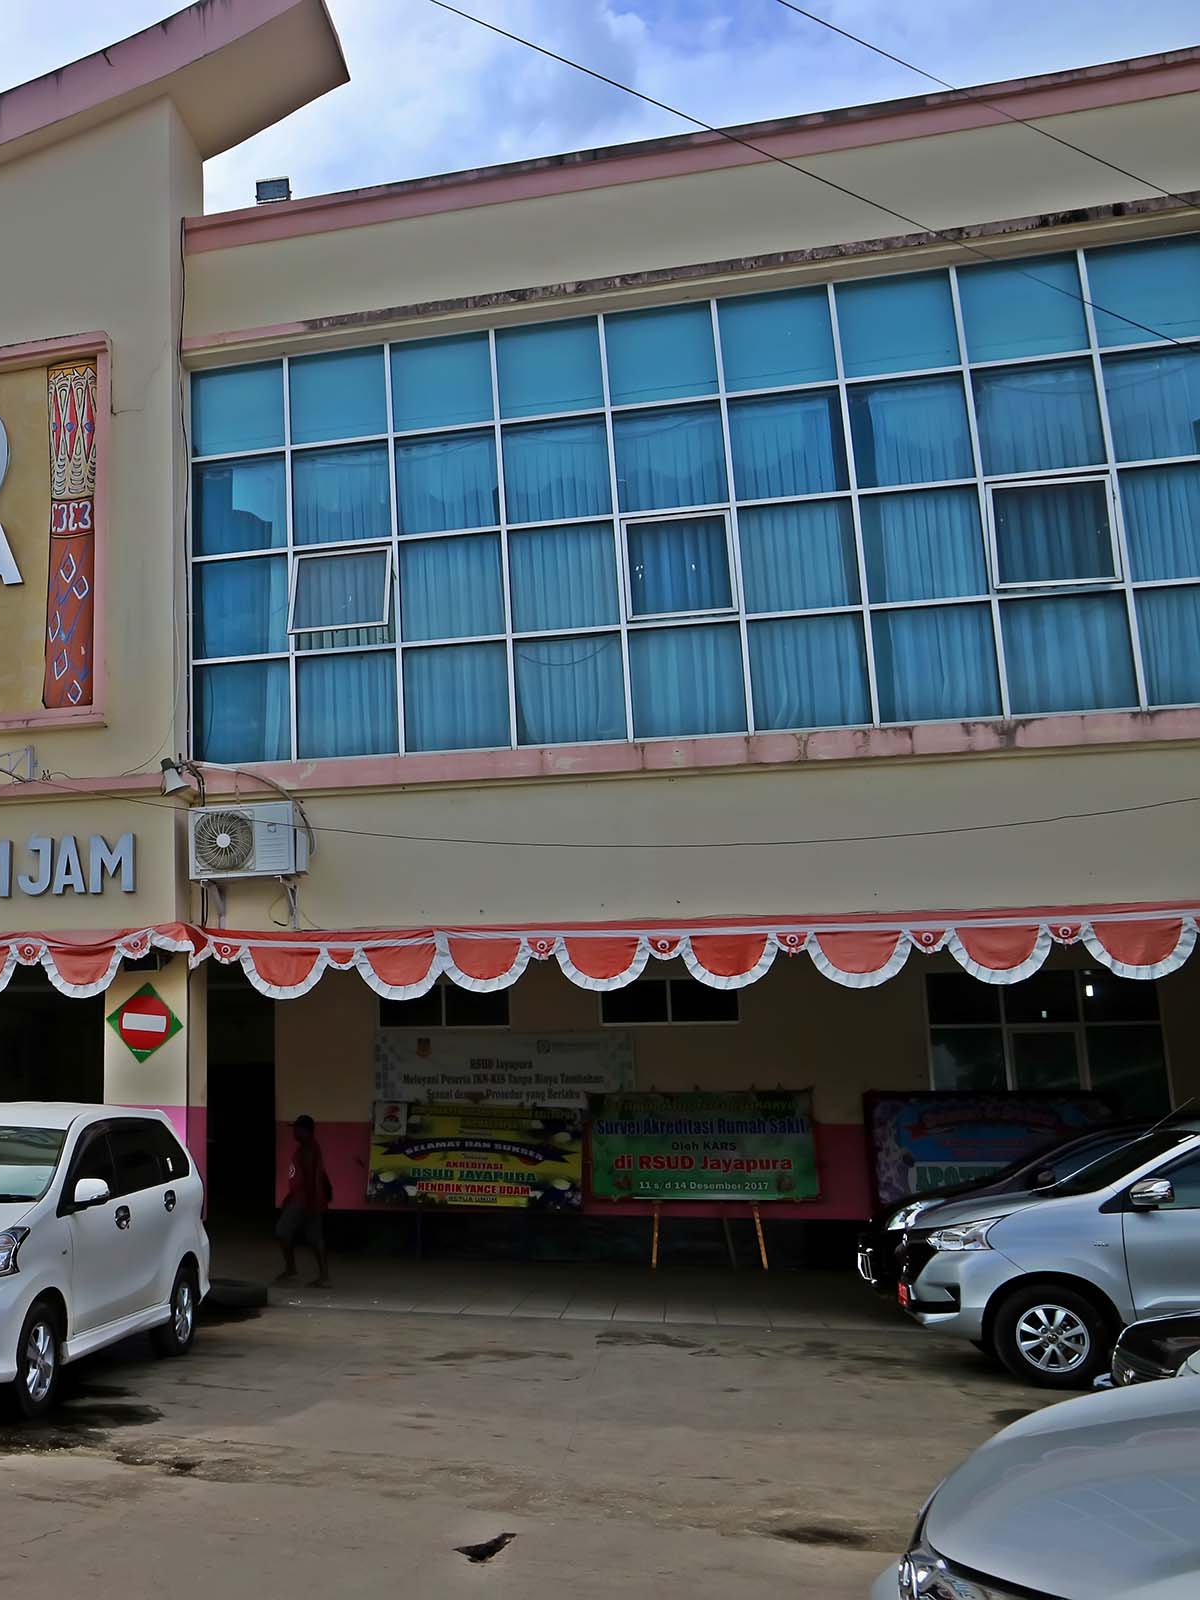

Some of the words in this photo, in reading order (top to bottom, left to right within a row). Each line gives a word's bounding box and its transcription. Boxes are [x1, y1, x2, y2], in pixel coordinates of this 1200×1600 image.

[598, 1118, 641, 1135] Survei
[642, 1118, 714, 1135] Akreditasi
[717, 1118, 768, 1135] Rumah
[770, 1117, 806, 1135] Sakit
[404, 1140, 462, 1155] SELAMAT
[493, 1141, 545, 1161] SUKSES
[671, 1141, 699, 1151] Oleh
[703, 1141, 737, 1151] KARS
[615, 1155, 633, 1169] di
[639, 1155, 695, 1170] RSUD
[701, 1156, 793, 1173] Jayapura
[411, 1167, 454, 1179] RSUD
[458, 1169, 537, 1182] JAYAPURA
[416, 1182, 463, 1193] HENDRIK
[465, 1184, 497, 1194] YANCE
[499, 1186, 531, 1195] UDAM
[639, 1182, 651, 1190] 11
[674, 1181, 687, 1190] 14
[744, 1182, 769, 1191] 2017
